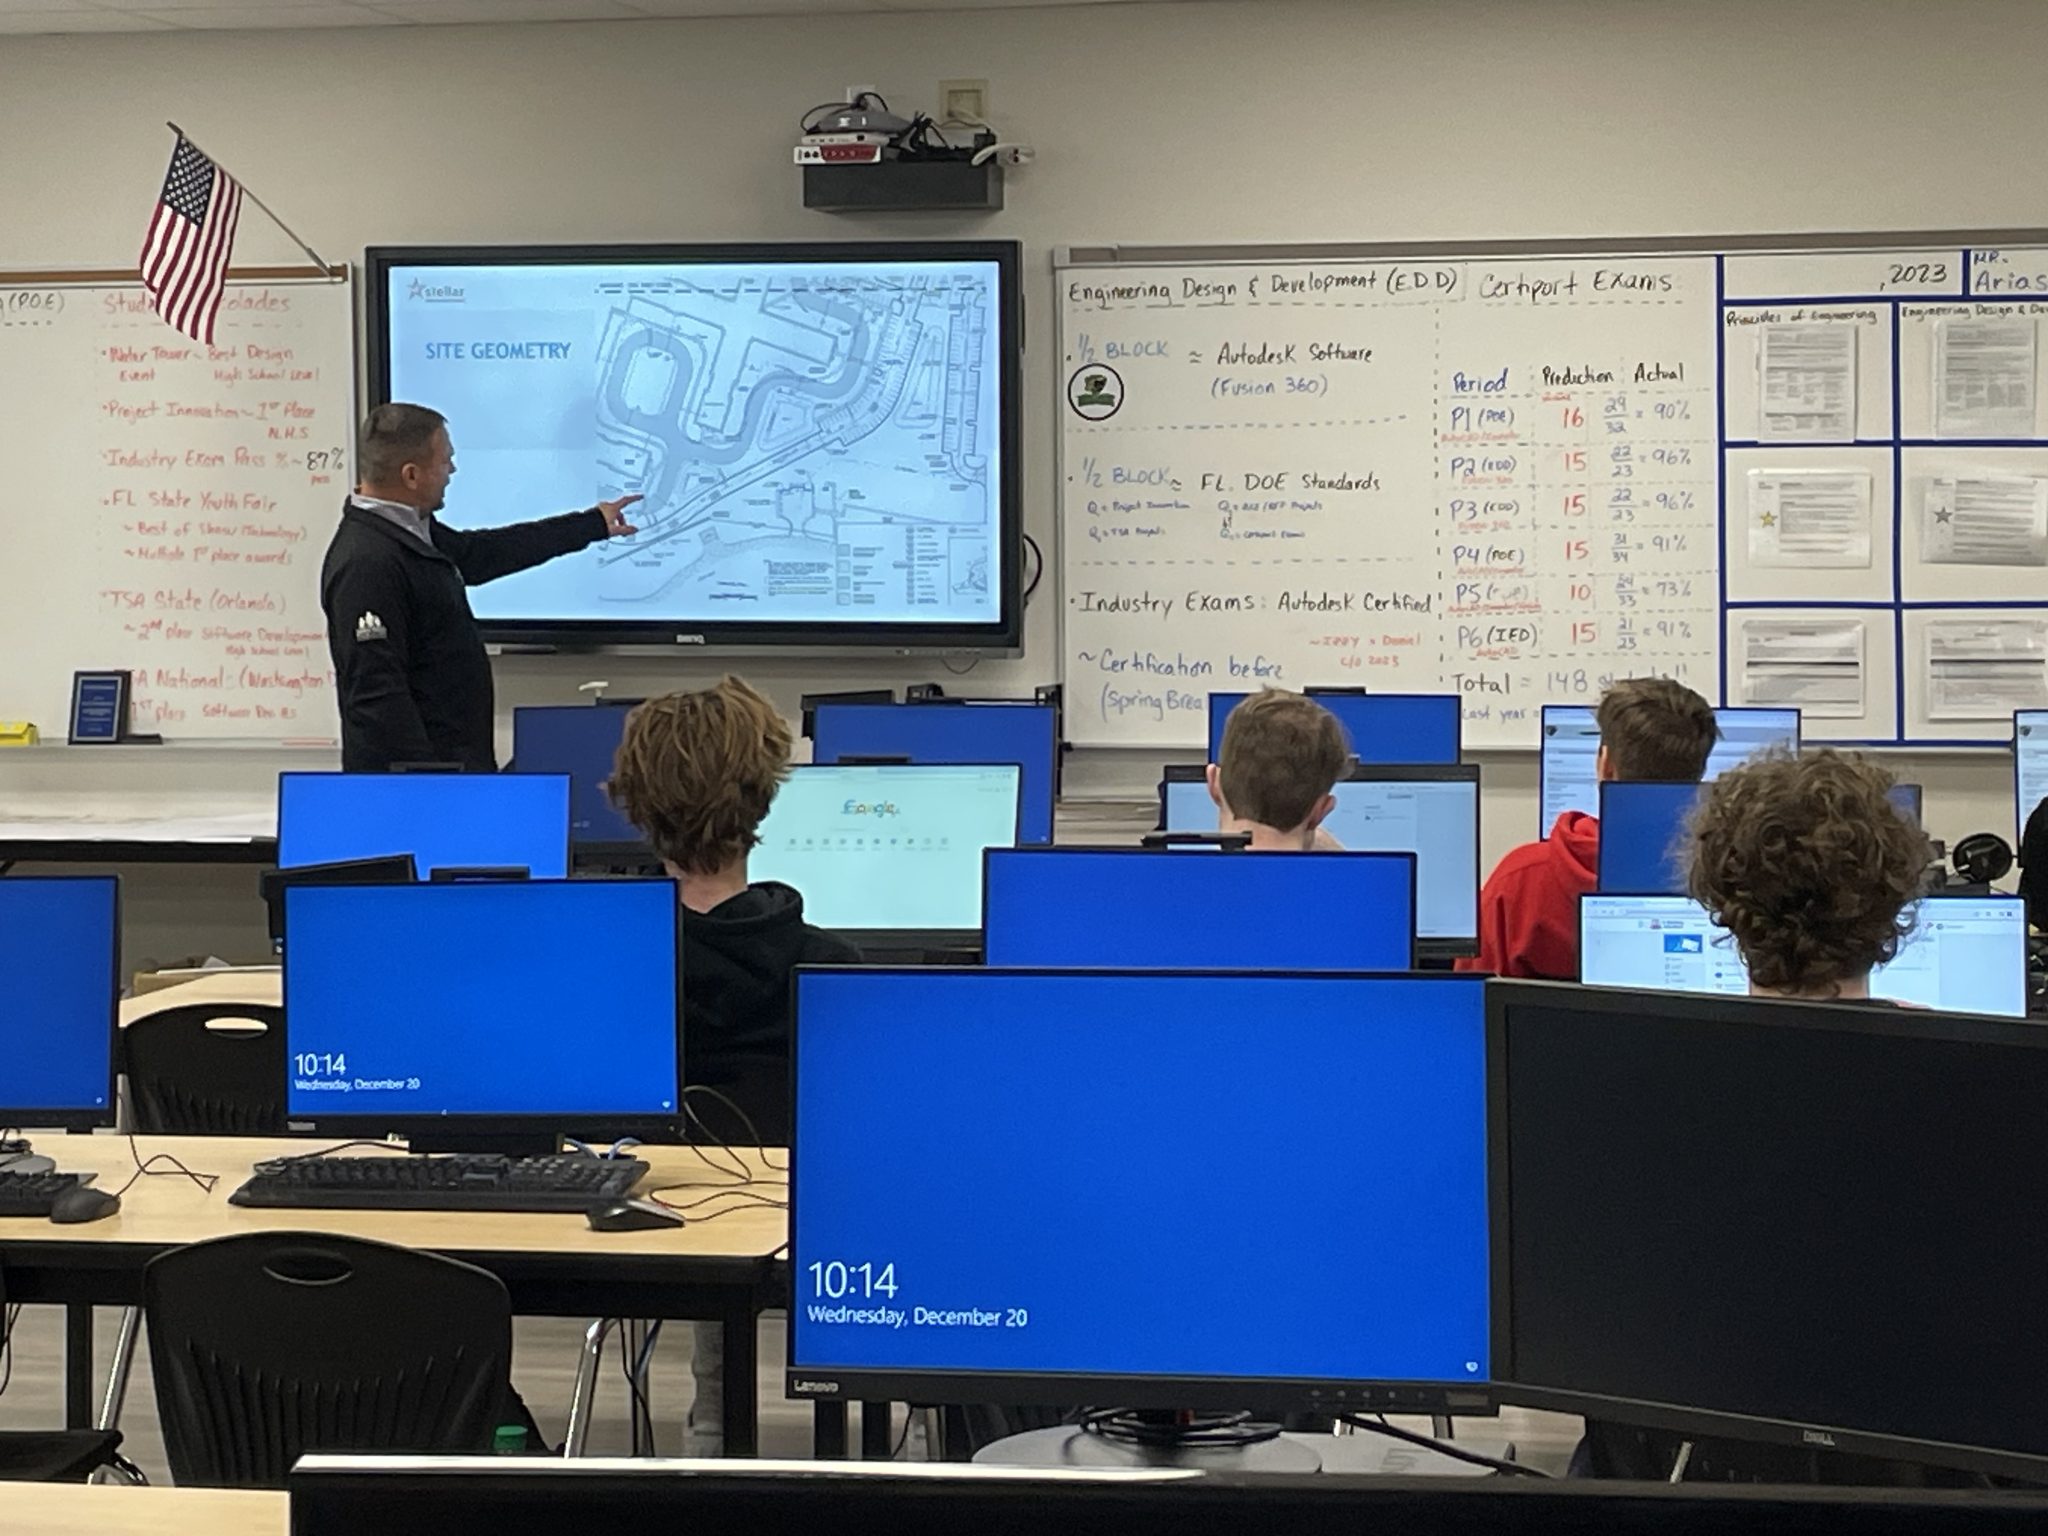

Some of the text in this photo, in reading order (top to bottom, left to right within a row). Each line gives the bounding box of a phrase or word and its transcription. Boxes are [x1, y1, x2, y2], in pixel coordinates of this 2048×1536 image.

[1069, 282, 1173, 310] Engineering
[1183, 277, 1238, 305] Design
[1271, 268, 1377, 297] Development
[1593, 268, 1674, 292] Exams
[1975, 271, 2048, 292] Arias
[1811, 309, 1877, 323] Engineering
[1902, 305, 1972, 323] Engineering
[1976, 304, 2013, 316] Design
[247, 345, 295, 365] Design
[426, 342, 572, 359] SITE GEOMETRY
[1105, 341, 1170, 361] BLOCK
[1310, 341, 1373, 364] Software
[119, 369, 156, 383] Event
[1453, 367, 1509, 393] Period
[1634, 361, 1685, 383] Actual
[1210, 376, 1276, 401] (Fusion
[109, 403, 159, 424] Project
[1451, 406, 1471, 432] P1
[1563, 406, 1585, 429] 16
[1654, 400, 1691, 420] 90%
[107, 448, 178, 471] Industry
[186, 449, 225, 467] Exam
[307, 446, 345, 473] 87%
[1451, 456, 1476, 479] P2
[1566, 452, 1587, 472] 15
[1652, 449, 1692, 466] 96%
[1112, 467, 1170, 485] BLOCK
[1244, 471, 1290, 491] DOE
[1302, 470, 1382, 492] Standards
[1611, 464, 1634, 478] 23
[111, 489, 278, 513] FL State Youth Fair
[1564, 494, 1587, 517] 15
[1612, 488, 1633, 502] 22
[1656, 490, 1695, 512] 96%
[1449, 499, 1478, 521] P3
[1612, 509, 1636, 522] 23
[1566, 541, 1590, 561] 15
[1652, 532, 1689, 553] 91%
[1453, 545, 1480, 566] P4
[1612, 551, 1631, 564] 34
[110, 590, 146, 609] TSA
[155, 588, 203, 612] State
[1456, 582, 1482, 604] P5
[1570, 584, 1592, 601] 10
[1656, 580, 1692, 598] 73%
[1079, 592, 1173, 621] Industry
[1363, 591, 1432, 613] Certified
[1571, 622, 1596, 645] 15
[1618, 617, 1634, 631] 21
[1656, 620, 1692, 640] 91%
[1457, 625, 1484, 649] P6
[1100, 648, 1283, 680] Certification before
[1452, 671, 1512, 696] Total
[1546, 669, 1589, 694] 148
[1102, 685, 1204, 723] (Spring Brea
[295, 1053, 347, 1076] 10:14
[354, 1078, 405, 1091] December
[406, 1078, 421, 1090] 20
[808, 1261, 899, 1299] 10:14
[807, 1305, 1029, 1330] Wednesday, December 20
